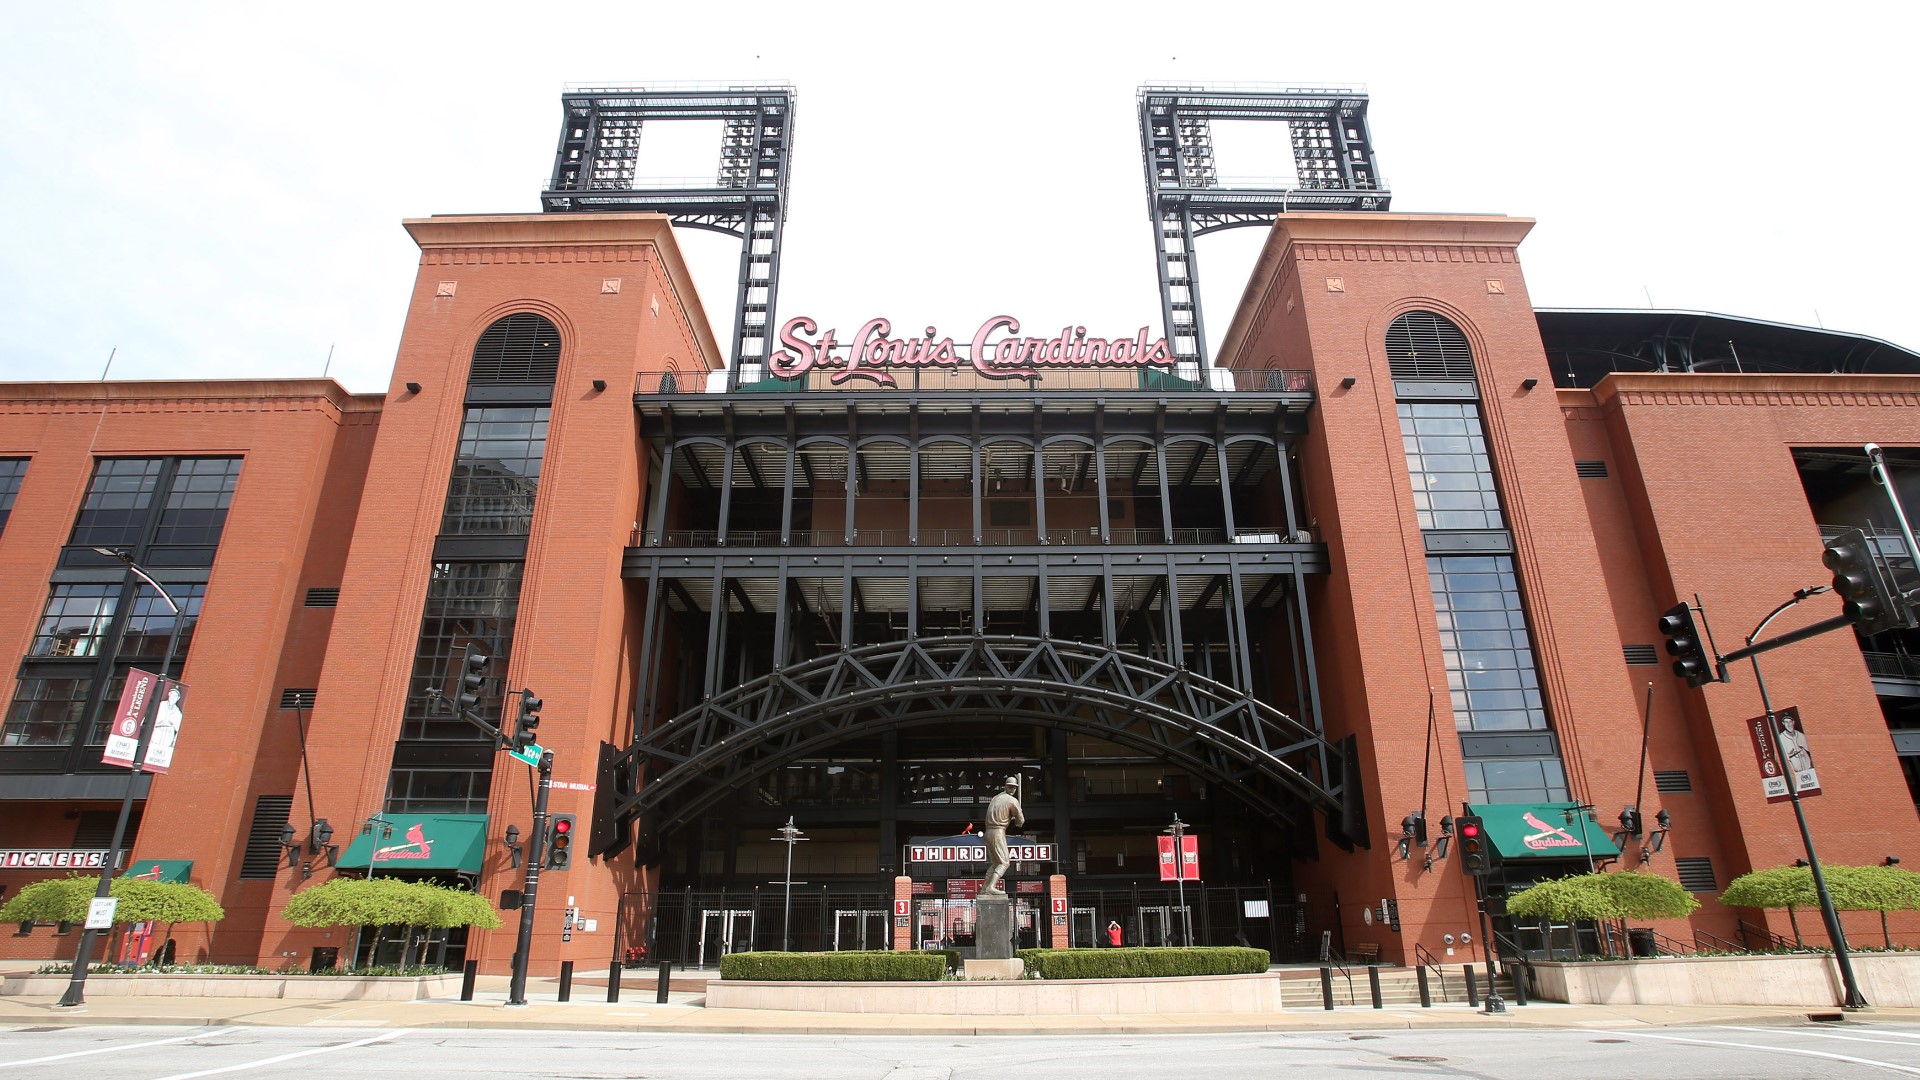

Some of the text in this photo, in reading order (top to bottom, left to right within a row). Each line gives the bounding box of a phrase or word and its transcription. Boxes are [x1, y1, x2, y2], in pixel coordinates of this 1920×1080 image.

[769, 315, 1178, 389] St. Louis Cardinals
[134, 676, 149, 708] LEGEND
[569, 783, 590, 791] MUSIAL
[1523, 836, 1583, 850] Cardinals
[372, 848, 430, 861] Cardinals
[914, 847, 1047, 860] THIRD ASE
